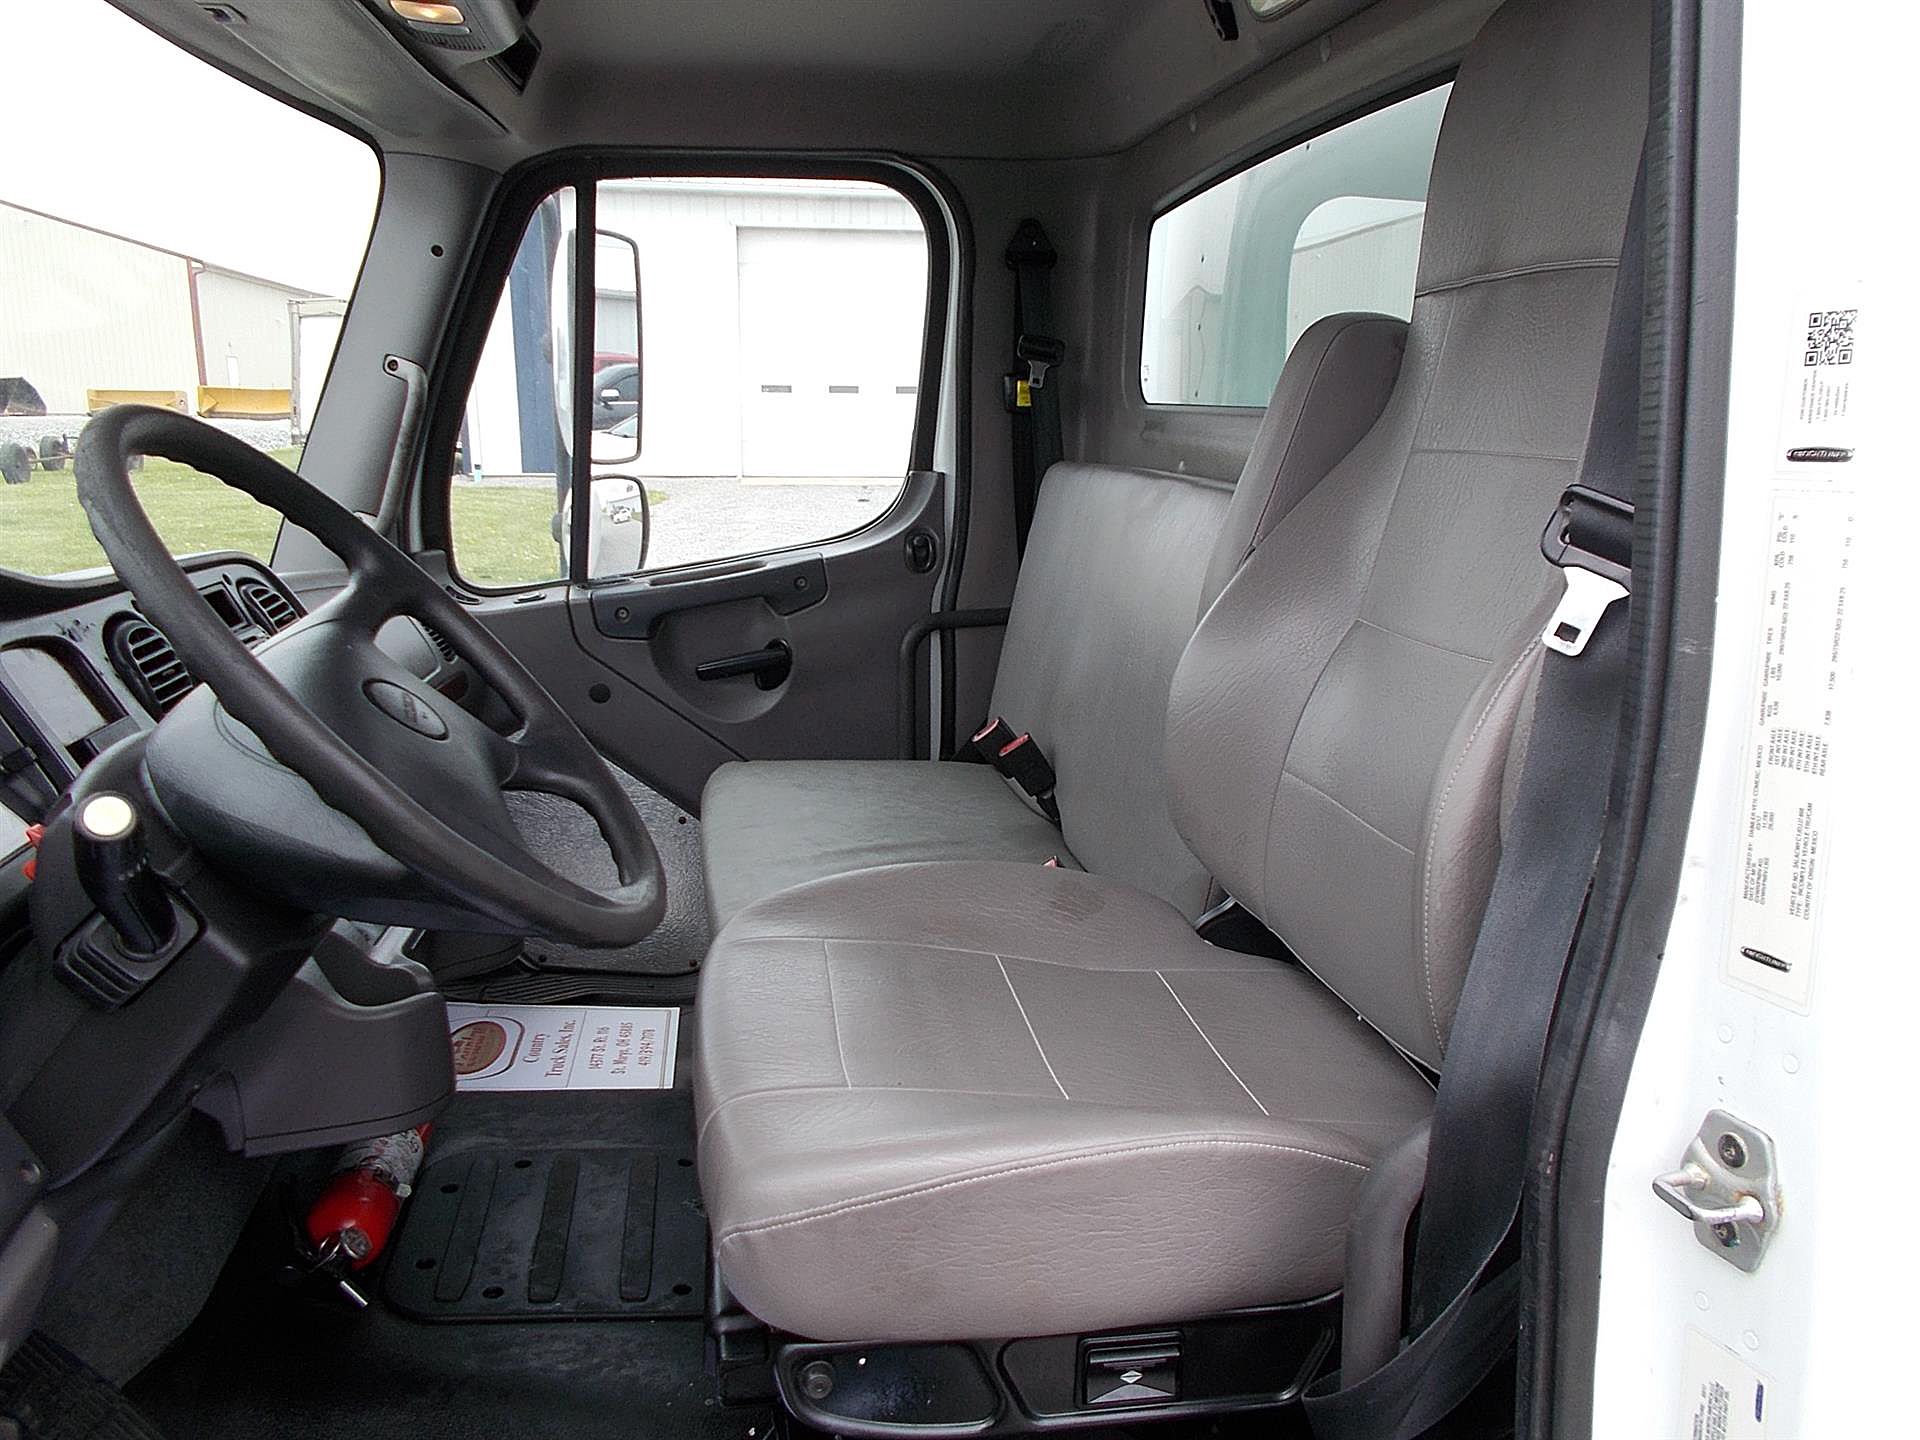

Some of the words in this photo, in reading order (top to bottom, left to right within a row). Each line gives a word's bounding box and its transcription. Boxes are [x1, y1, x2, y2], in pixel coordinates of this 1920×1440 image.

[522, 1033, 550, 1063] Country
[544, 1055, 567, 1077] Truck
[558, 1020, 576, 1033] Inc.
